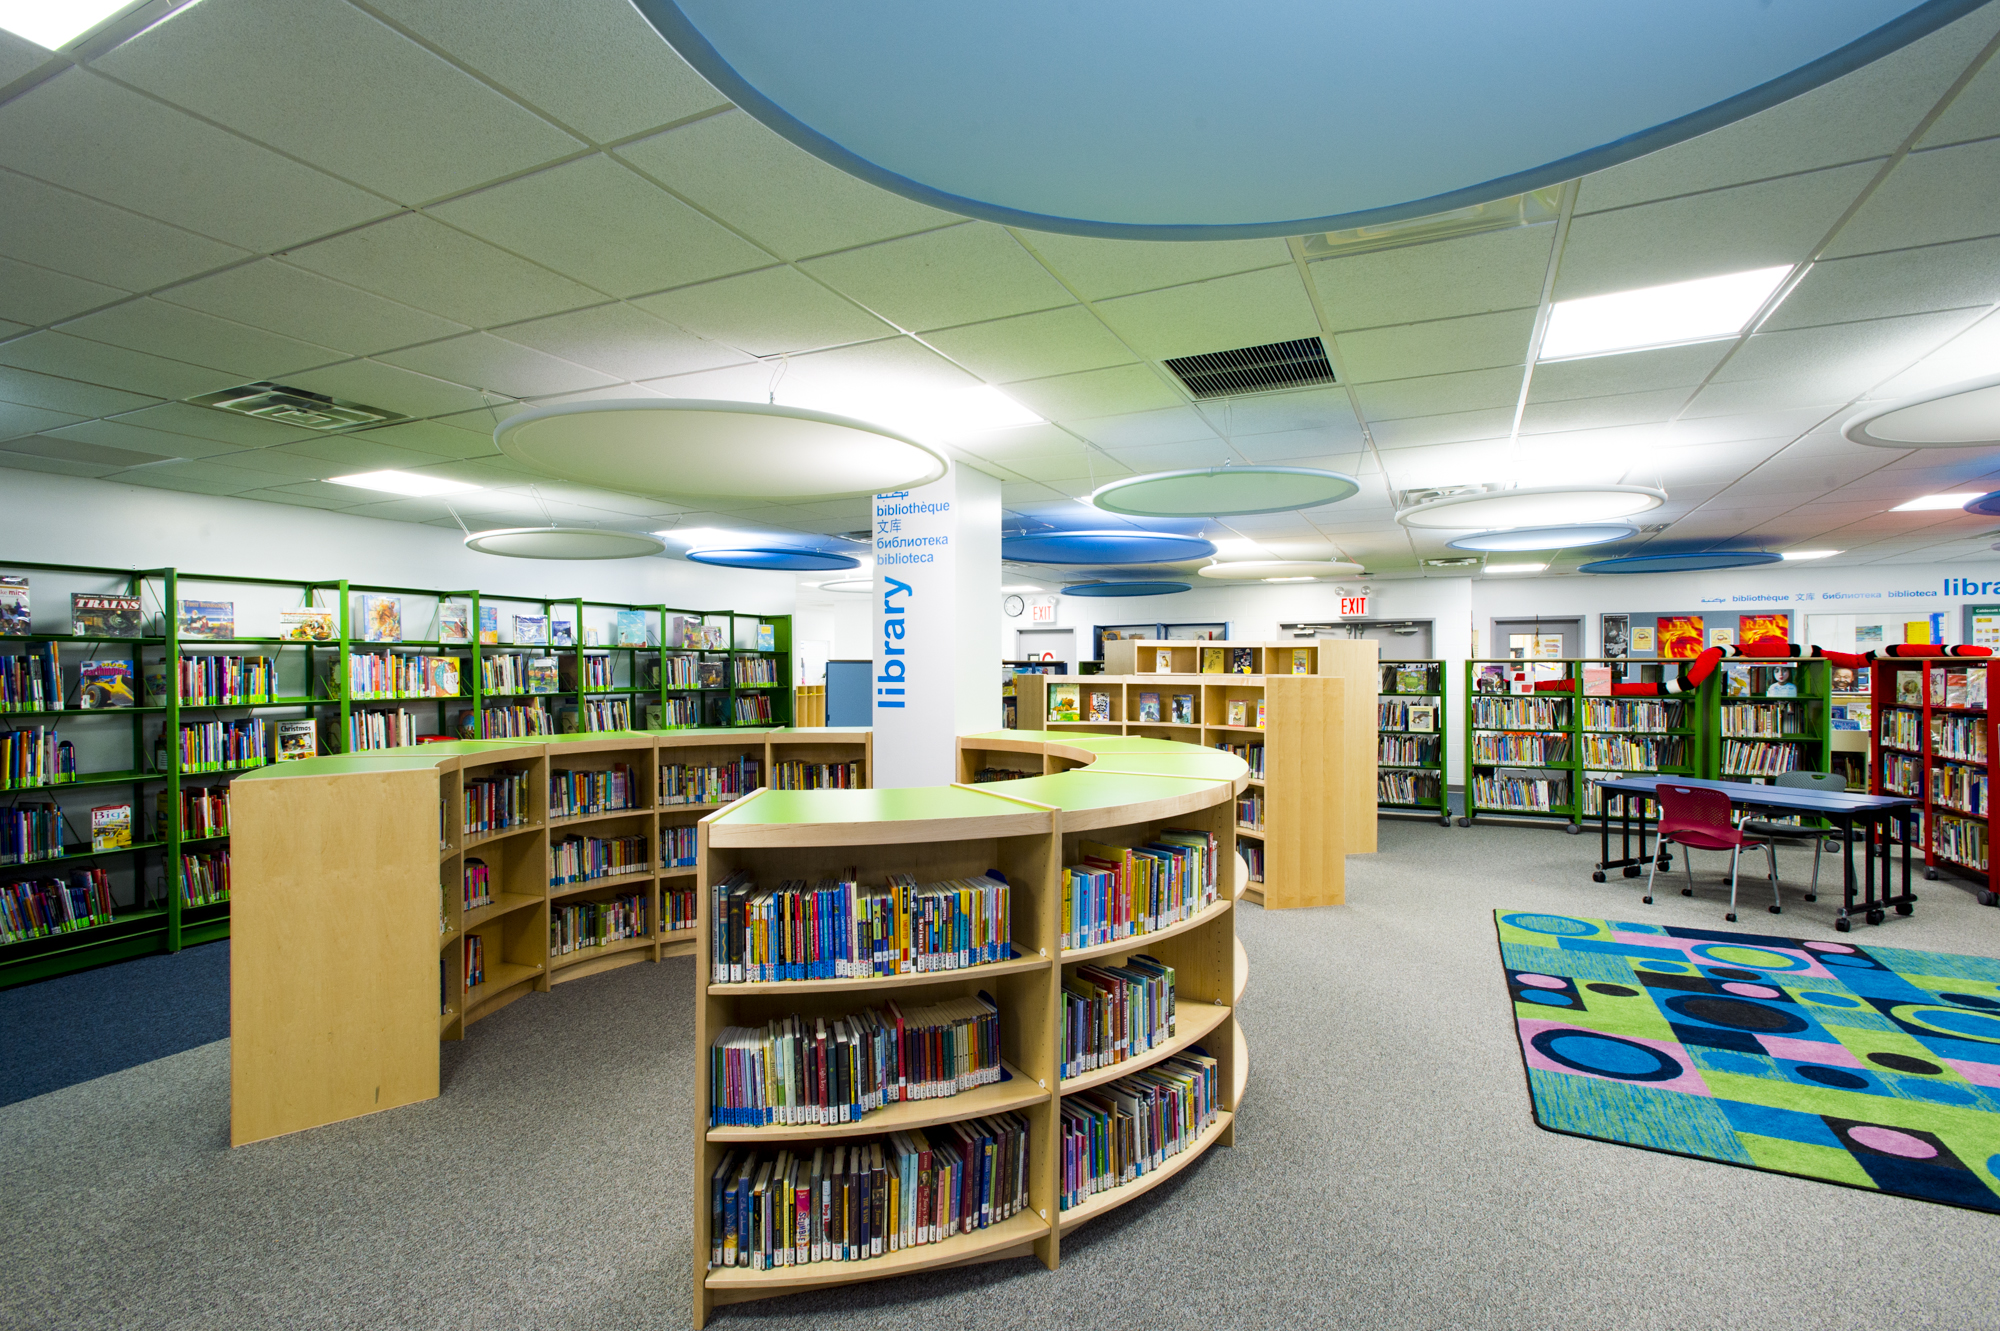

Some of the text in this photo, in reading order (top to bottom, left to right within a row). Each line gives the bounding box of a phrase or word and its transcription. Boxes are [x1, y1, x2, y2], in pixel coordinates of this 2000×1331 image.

[877, 501, 950, 517] bibliothèque
[877, 518, 902, 534] 文库
[877, 535, 949, 549] библиотека
[877, 552, 934, 565] biblioteca
[1732, 593, 1790, 602] bibliothèque
[1795, 592, 1815, 602] 文库
[1822, 590, 1882, 600] библиотека
[1887, 588, 1937, 598] biblioteca
[75, 598, 140, 610] TRAINS
[1341, 597, 1367, 616] EXIT
[1033, 605, 1053, 621] EXIT
[878, 576, 912, 708] library
[94, 811, 120, 820] Big
[798, 1212, 806, 1242] SCUMBLE
